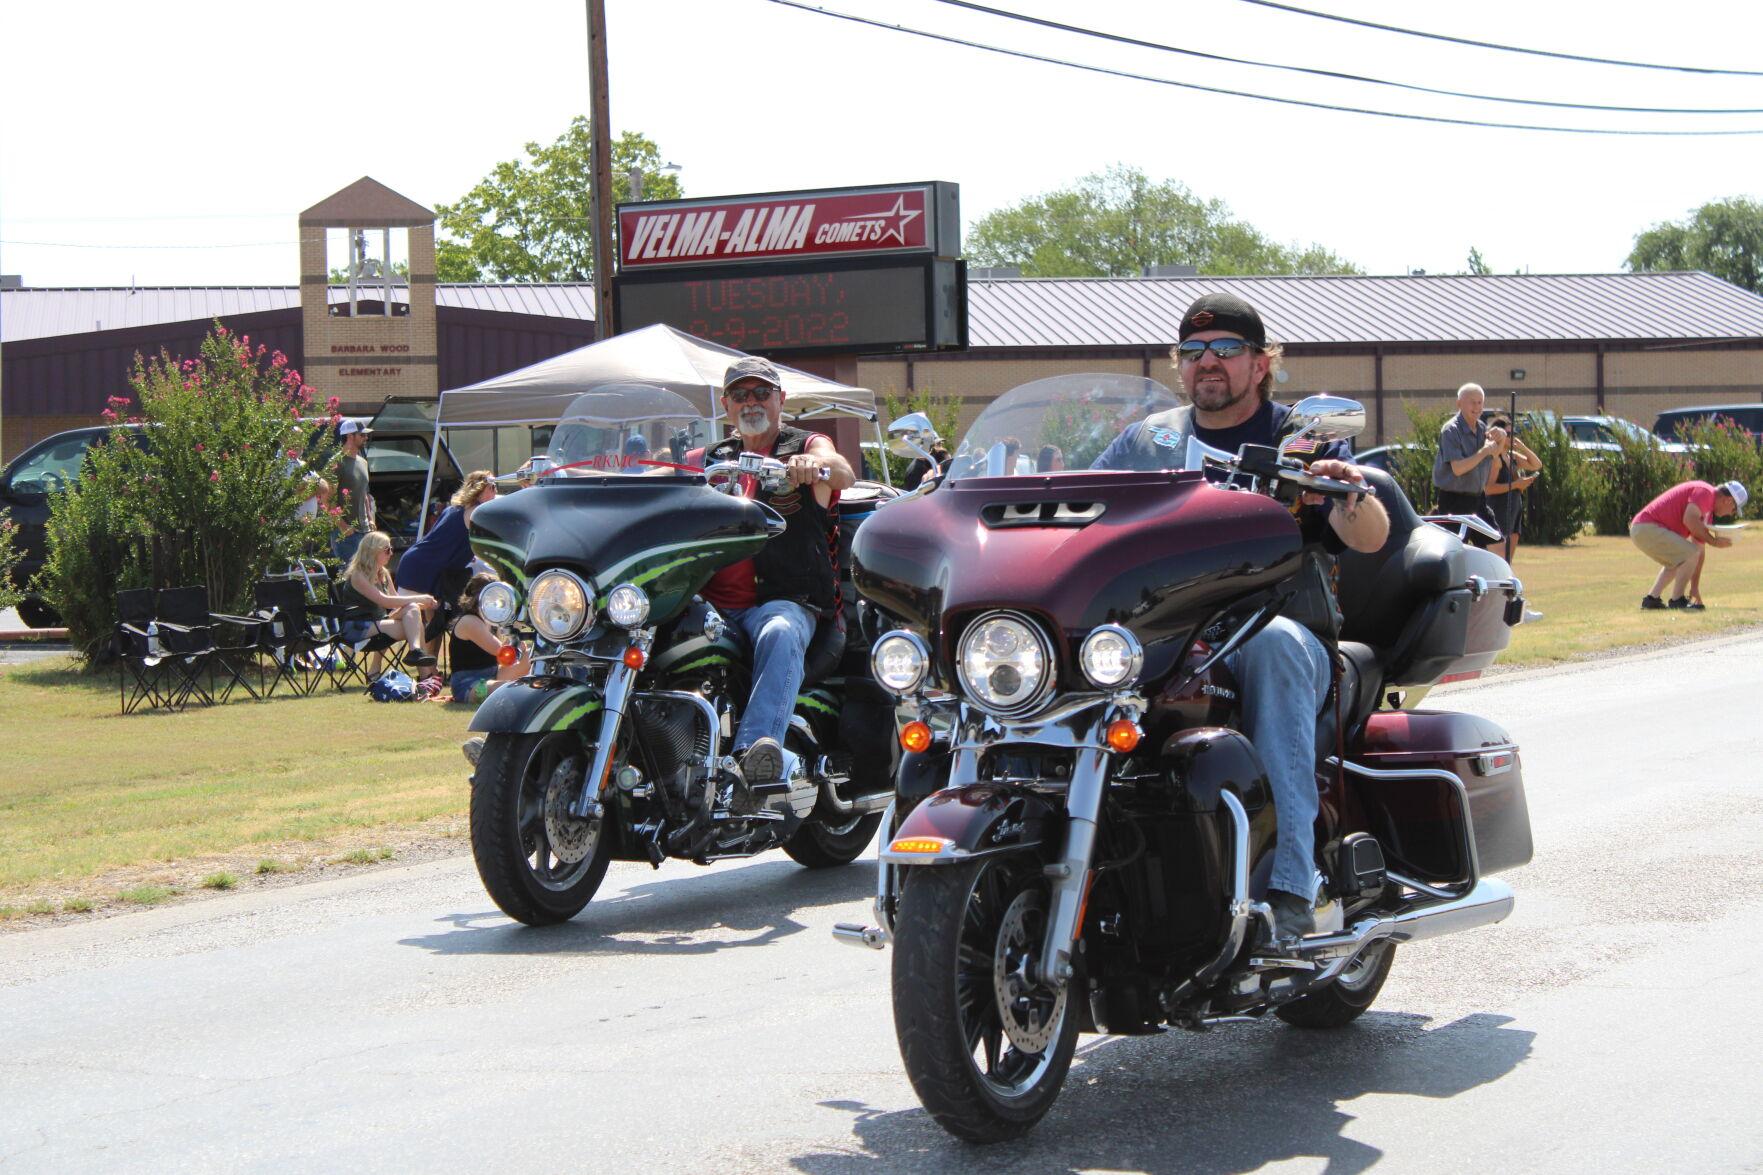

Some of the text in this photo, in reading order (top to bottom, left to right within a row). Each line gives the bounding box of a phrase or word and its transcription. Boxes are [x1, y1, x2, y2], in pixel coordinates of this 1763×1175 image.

[628, 204, 886, 259] VELMA-ALMA COMETS
[687, 272, 846, 312] TUESDAY,
[331, 345, 410, 353] BARBARA WOOD
[339, 368, 401, 376] ELEMENTARY
